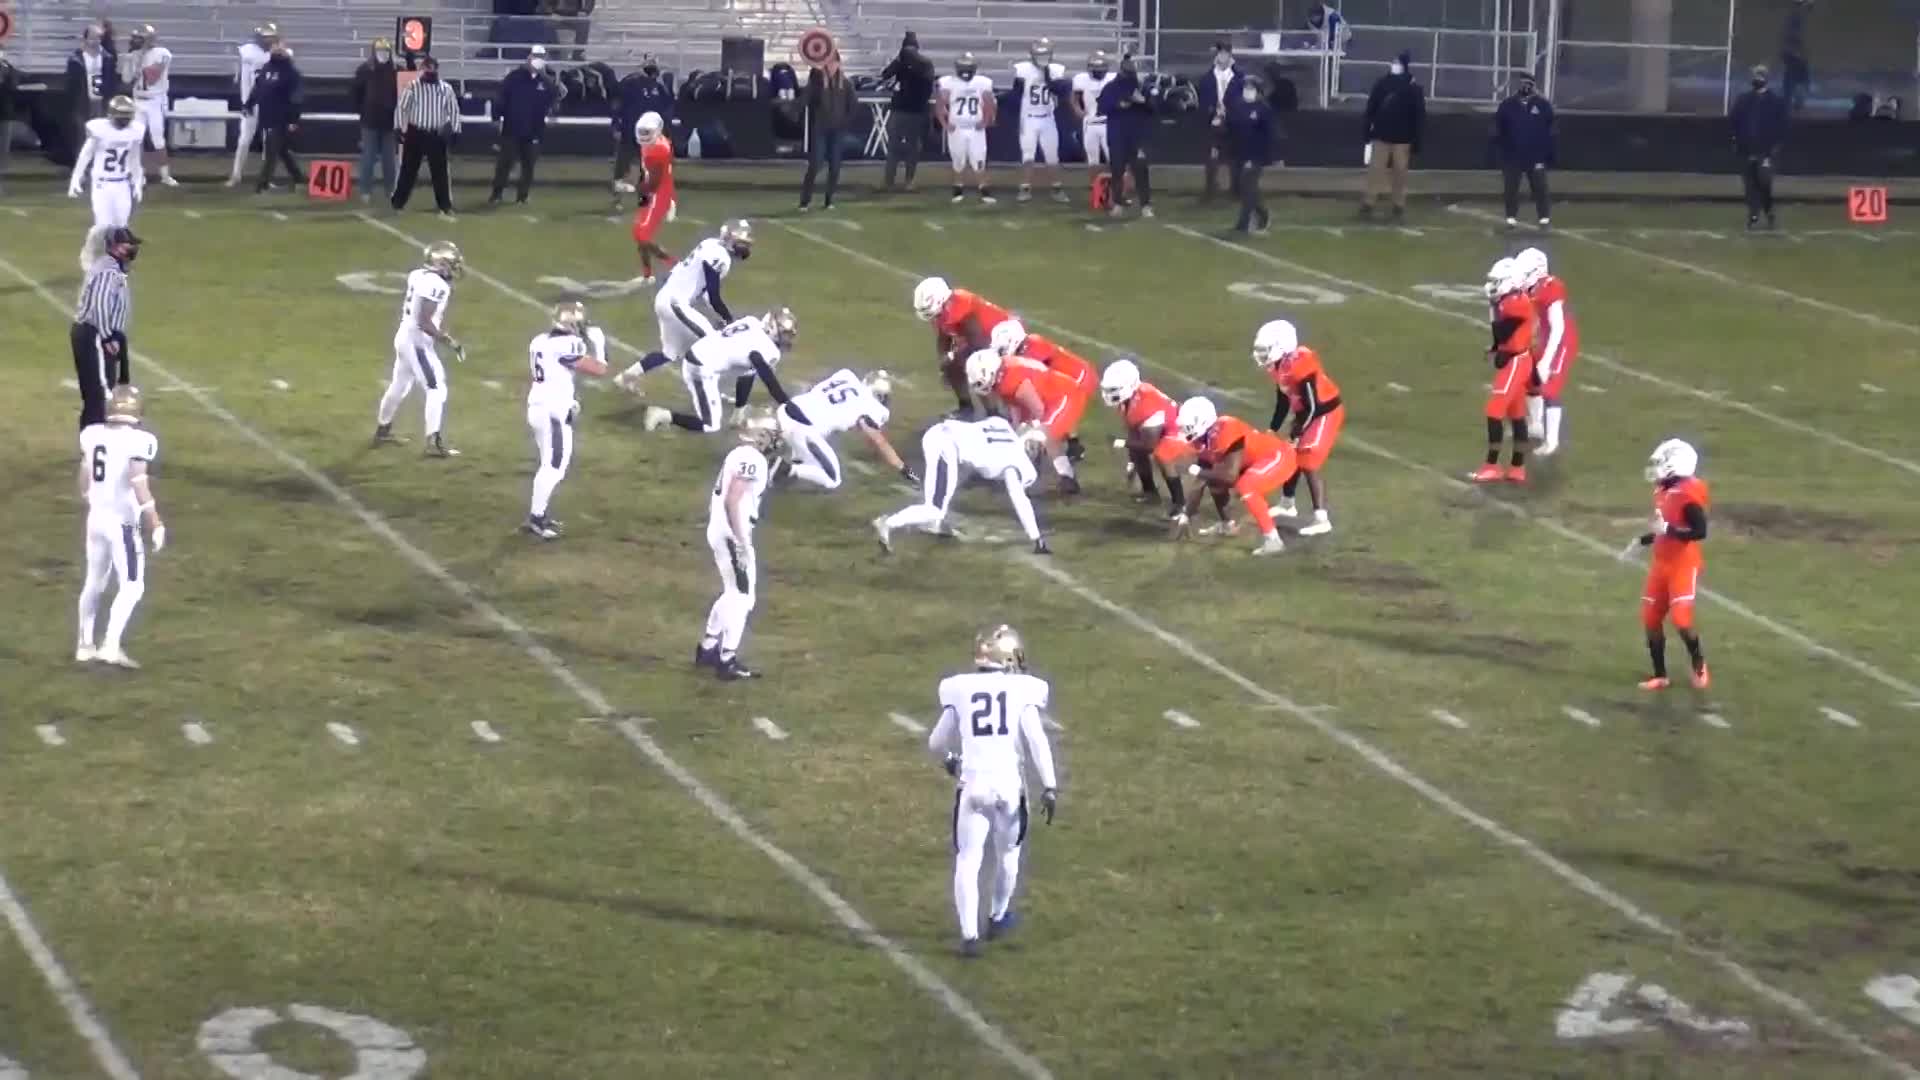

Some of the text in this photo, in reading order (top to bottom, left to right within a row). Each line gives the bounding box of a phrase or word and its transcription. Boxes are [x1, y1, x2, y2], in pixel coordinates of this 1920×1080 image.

[405, 20, 424, 50] 3
[955, 97, 978, 115] 70
[313, 165, 344, 194] 40
[1855, 190, 1881, 216] 20
[822, 380, 859, 405] 45
[983, 426, 1014, 443] 11
[93, 444, 107, 482] 6
[739, 462, 757, 475] 30
[971, 691, 1009, 737] 21
